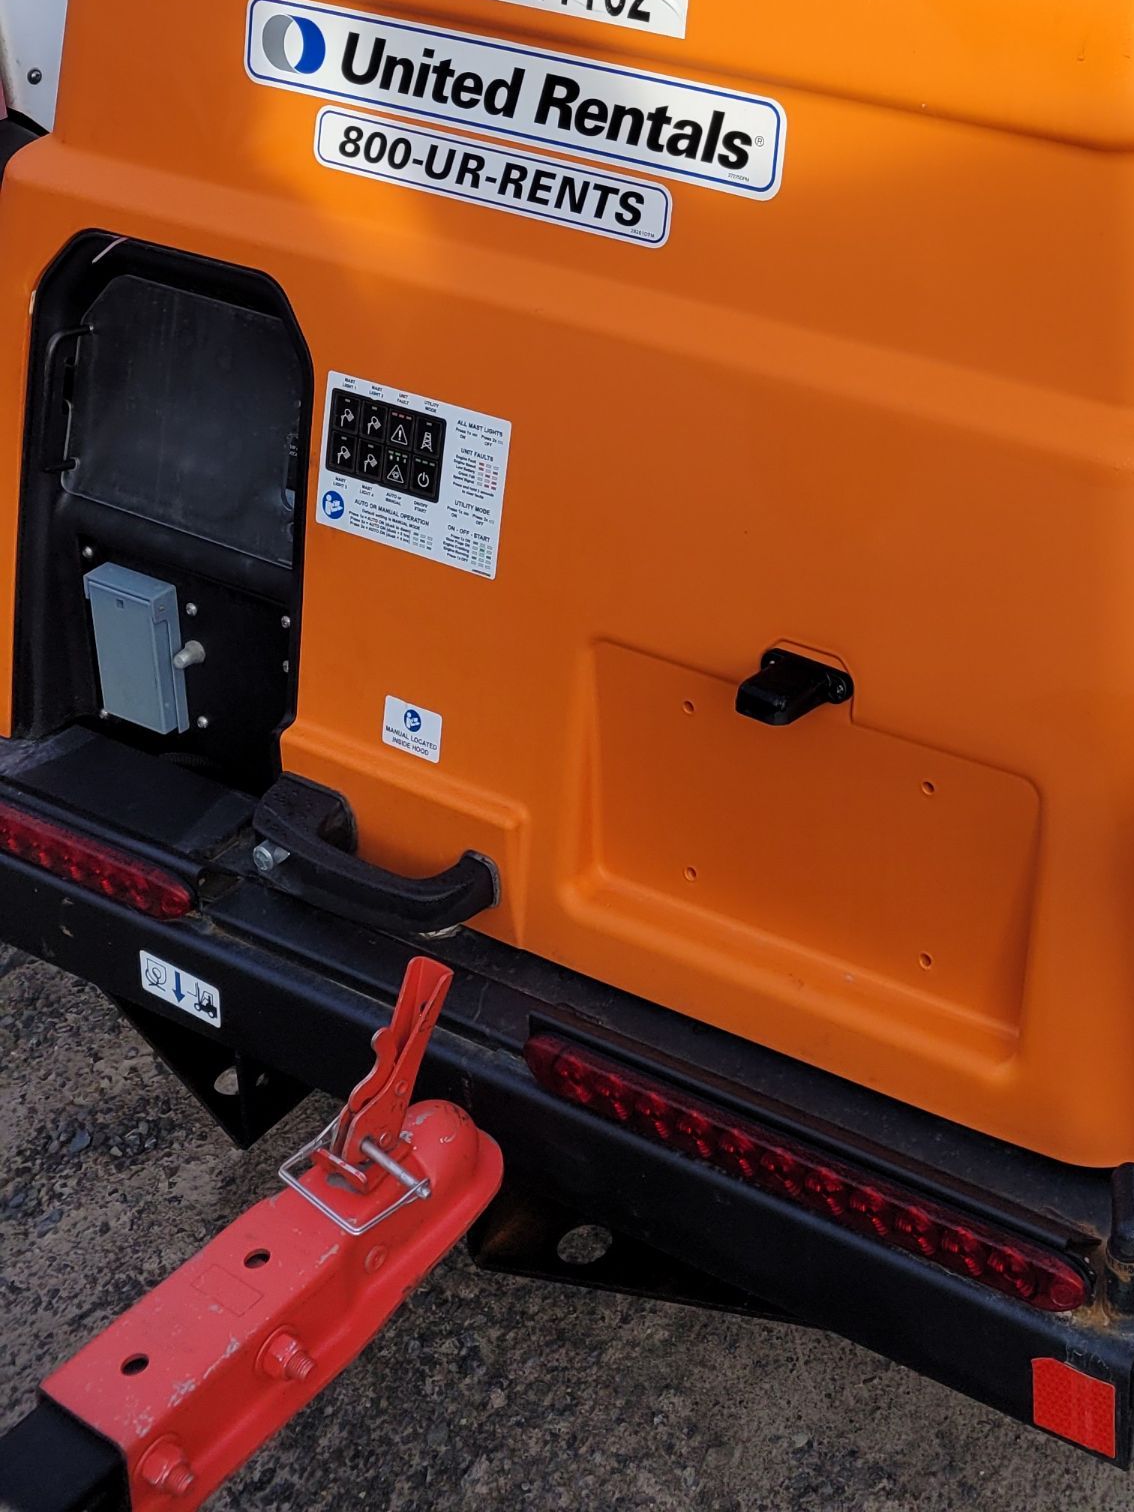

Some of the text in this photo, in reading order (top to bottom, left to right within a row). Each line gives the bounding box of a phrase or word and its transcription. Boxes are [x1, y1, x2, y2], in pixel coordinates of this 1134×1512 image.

[341, 32, 752, 170] United Rentals
[338, 125, 645, 227] 800-UR-RENTS
[468, 422, 482, 431] MAST
[483, 427, 502, 436] LIGHTS
[460, 447, 493, 461] UNIT FAULTS
[354, 498, 368, 507] AUTO
[378, 505, 399, 516] MANUAL
[400, 512, 429, 526] OPERATION
[454, 499, 490, 515] UTILITY MODE
[459, 528, 469, 536] OFF
[473, 532, 489, 542] START
[386, 725, 438, 750] MANUAL LOCATED
[392, 736, 429, 756] INSIDE HOOD
